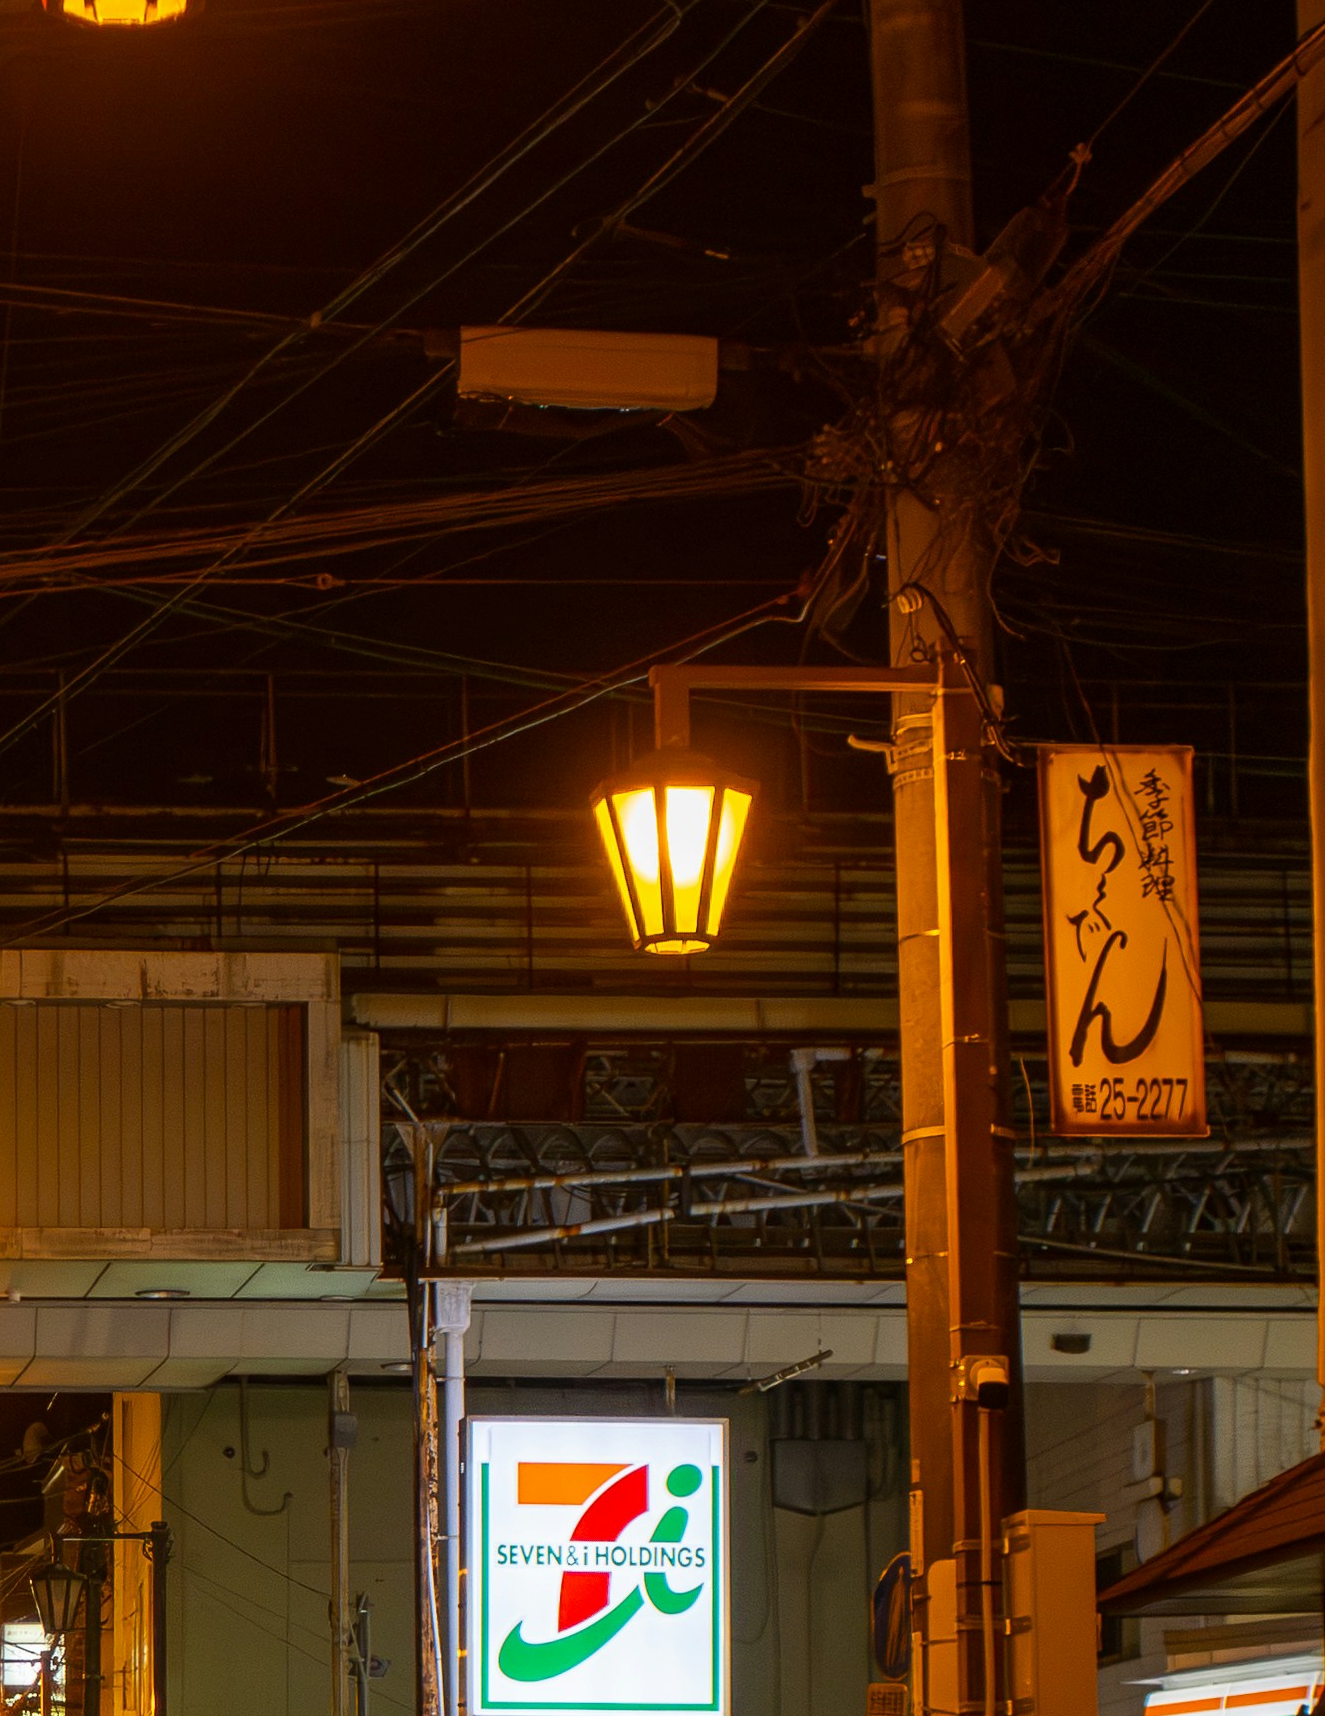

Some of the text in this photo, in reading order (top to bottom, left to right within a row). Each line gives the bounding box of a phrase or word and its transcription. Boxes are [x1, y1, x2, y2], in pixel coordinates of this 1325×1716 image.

[1134, 766, 1174, 902] 季節料理
[1100, 1077, 1188, 1120] 25-2277
[595, 1543, 706, 1568] HOLDINGS
